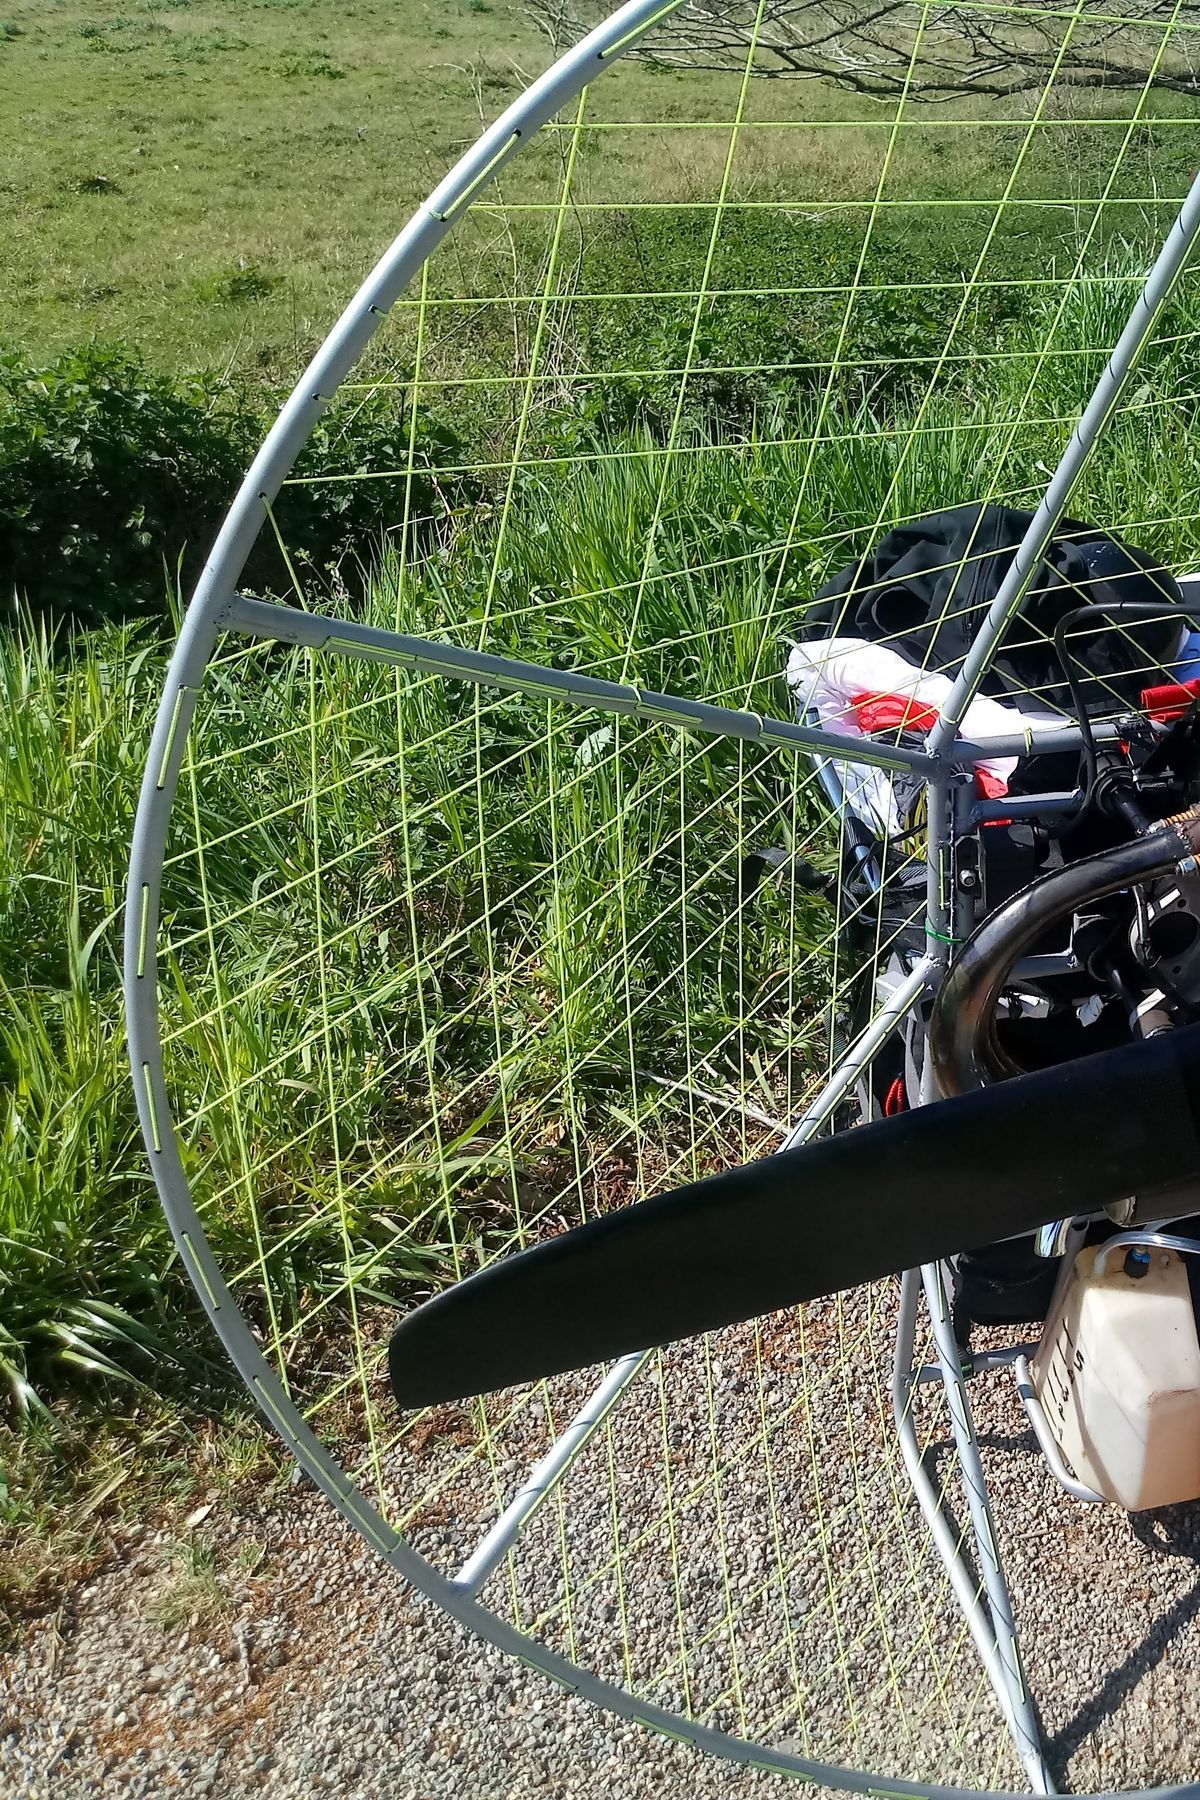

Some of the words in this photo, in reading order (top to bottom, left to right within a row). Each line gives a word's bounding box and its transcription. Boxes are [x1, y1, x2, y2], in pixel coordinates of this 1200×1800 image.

[1073, 1349, 1085, 1372] 5
[1063, 1386, 1069, 1402] 3
[1058, 1402, 1066, 1422] 2
